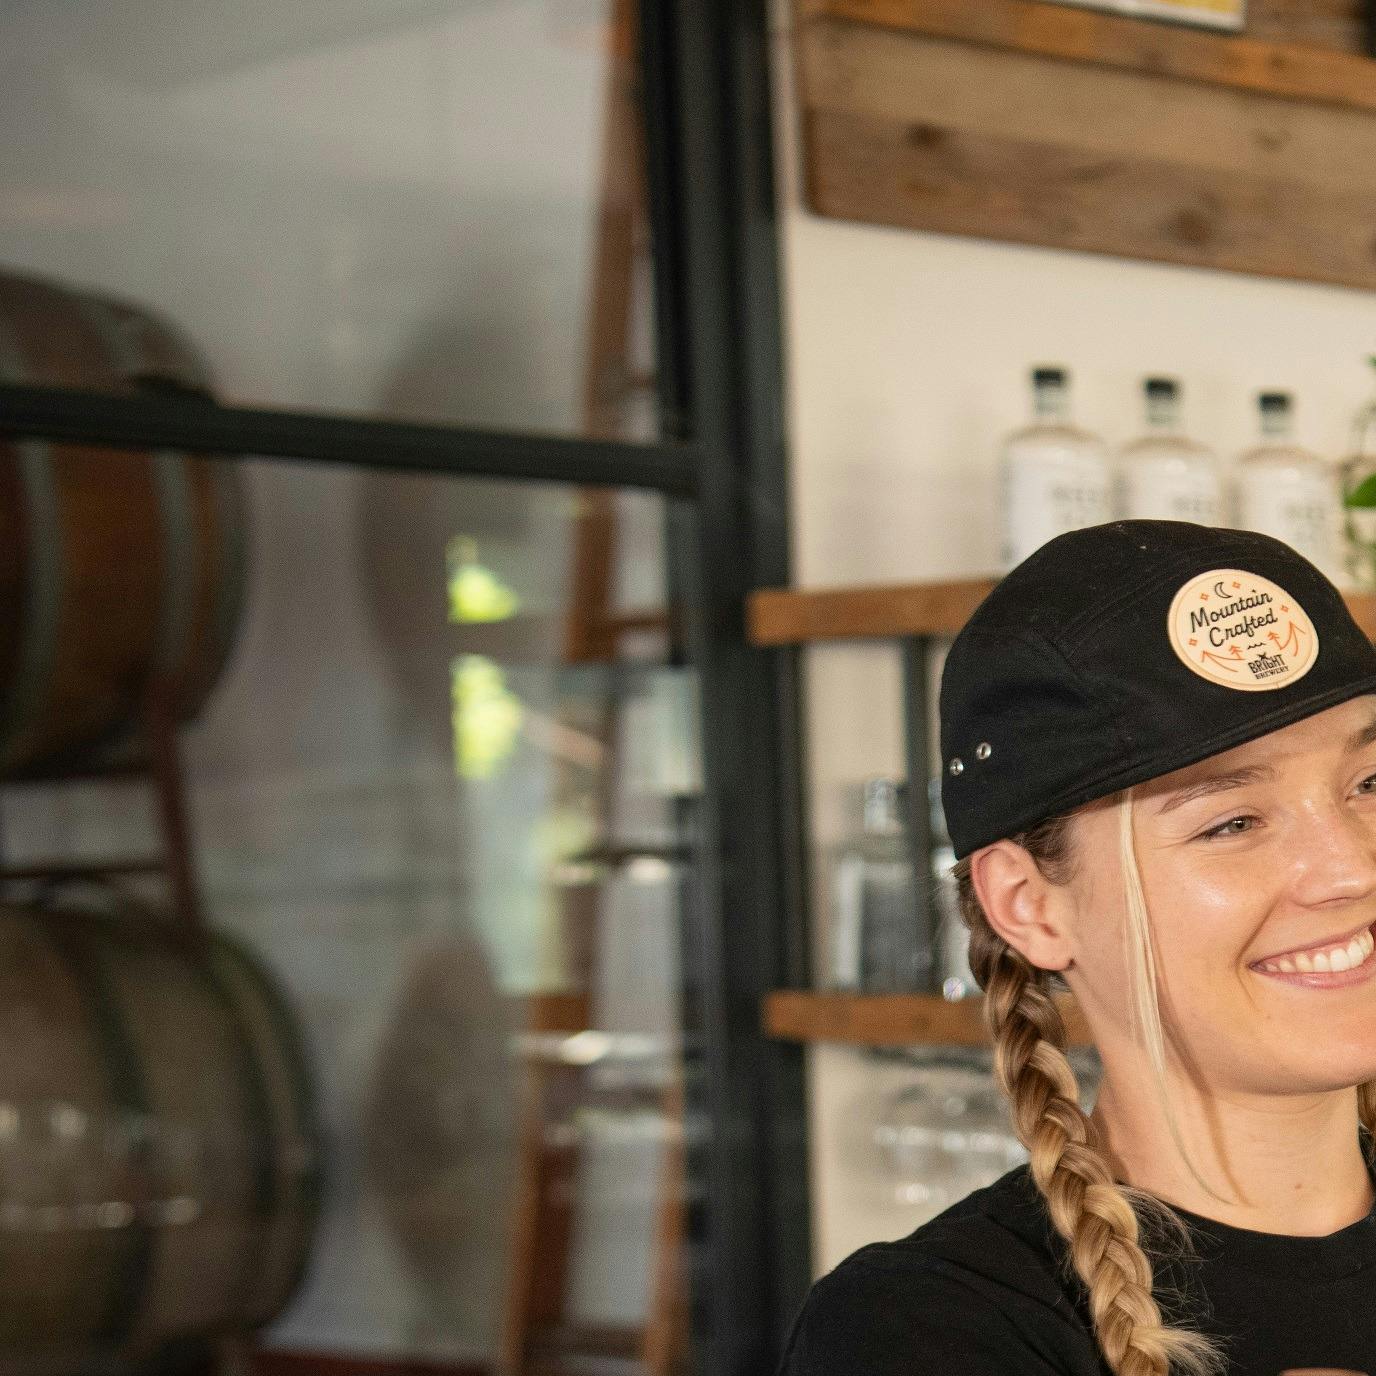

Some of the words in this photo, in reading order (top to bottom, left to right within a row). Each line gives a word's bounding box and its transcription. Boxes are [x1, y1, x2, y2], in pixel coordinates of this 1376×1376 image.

[1190, 589, 1273, 633] Mountain
[1209, 608, 1278, 647] Crafted
[1255, 665, 1289, 680] BREWERY
